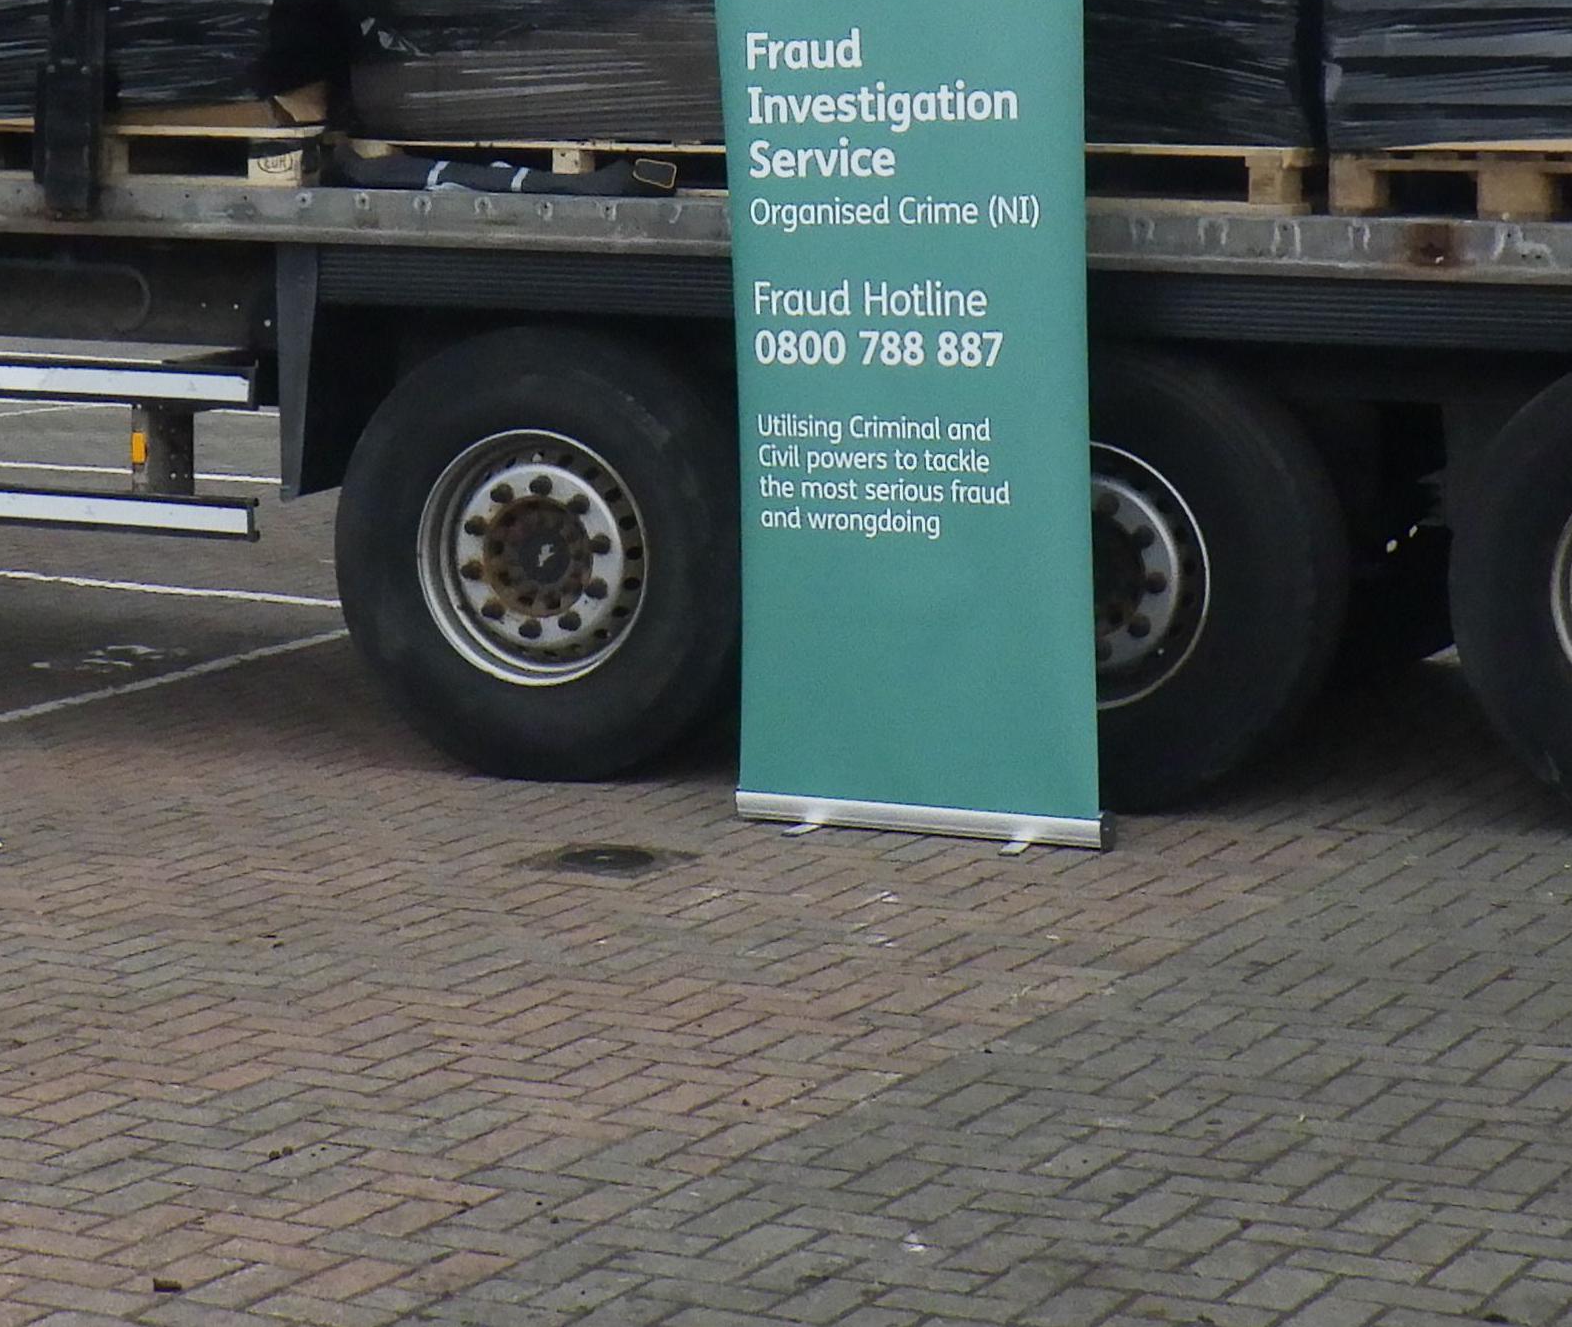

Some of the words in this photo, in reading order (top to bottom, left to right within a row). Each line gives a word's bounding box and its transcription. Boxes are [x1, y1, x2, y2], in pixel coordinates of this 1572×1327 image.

[745, 27, 862, 70] Fraud
[746, 80, 1018, 133] Investigation
[748, 137, 896, 178] Service
[750, 195, 889, 232] Organised
[898, 195, 979, 225] Crime
[988, 194, 1040, 228] (NI)
[753, 279, 851, 316] Fraud
[863, 280, 988, 317] Hotline
[754, 329, 847, 365] 0800
[858, 331, 925, 366] 788
[936, 331, 1004, 368] 887
[757, 413, 843, 444] Utilising
[849, 415, 940, 440] Criminal
[947, 418, 991, 441] and
[758, 444, 800, 468] Civil
[806, 450, 887, 473] powers
[894, 451, 917, 471] to
[924, 449, 990, 473] tackle
[759, 476, 794, 499] the
[801, 480, 857, 500] most
[865, 481, 944, 503] serious
[950, 480, 1009, 505] fraud
[761, 506, 801, 529] and
[807, 509, 941, 540] wrongdoing
